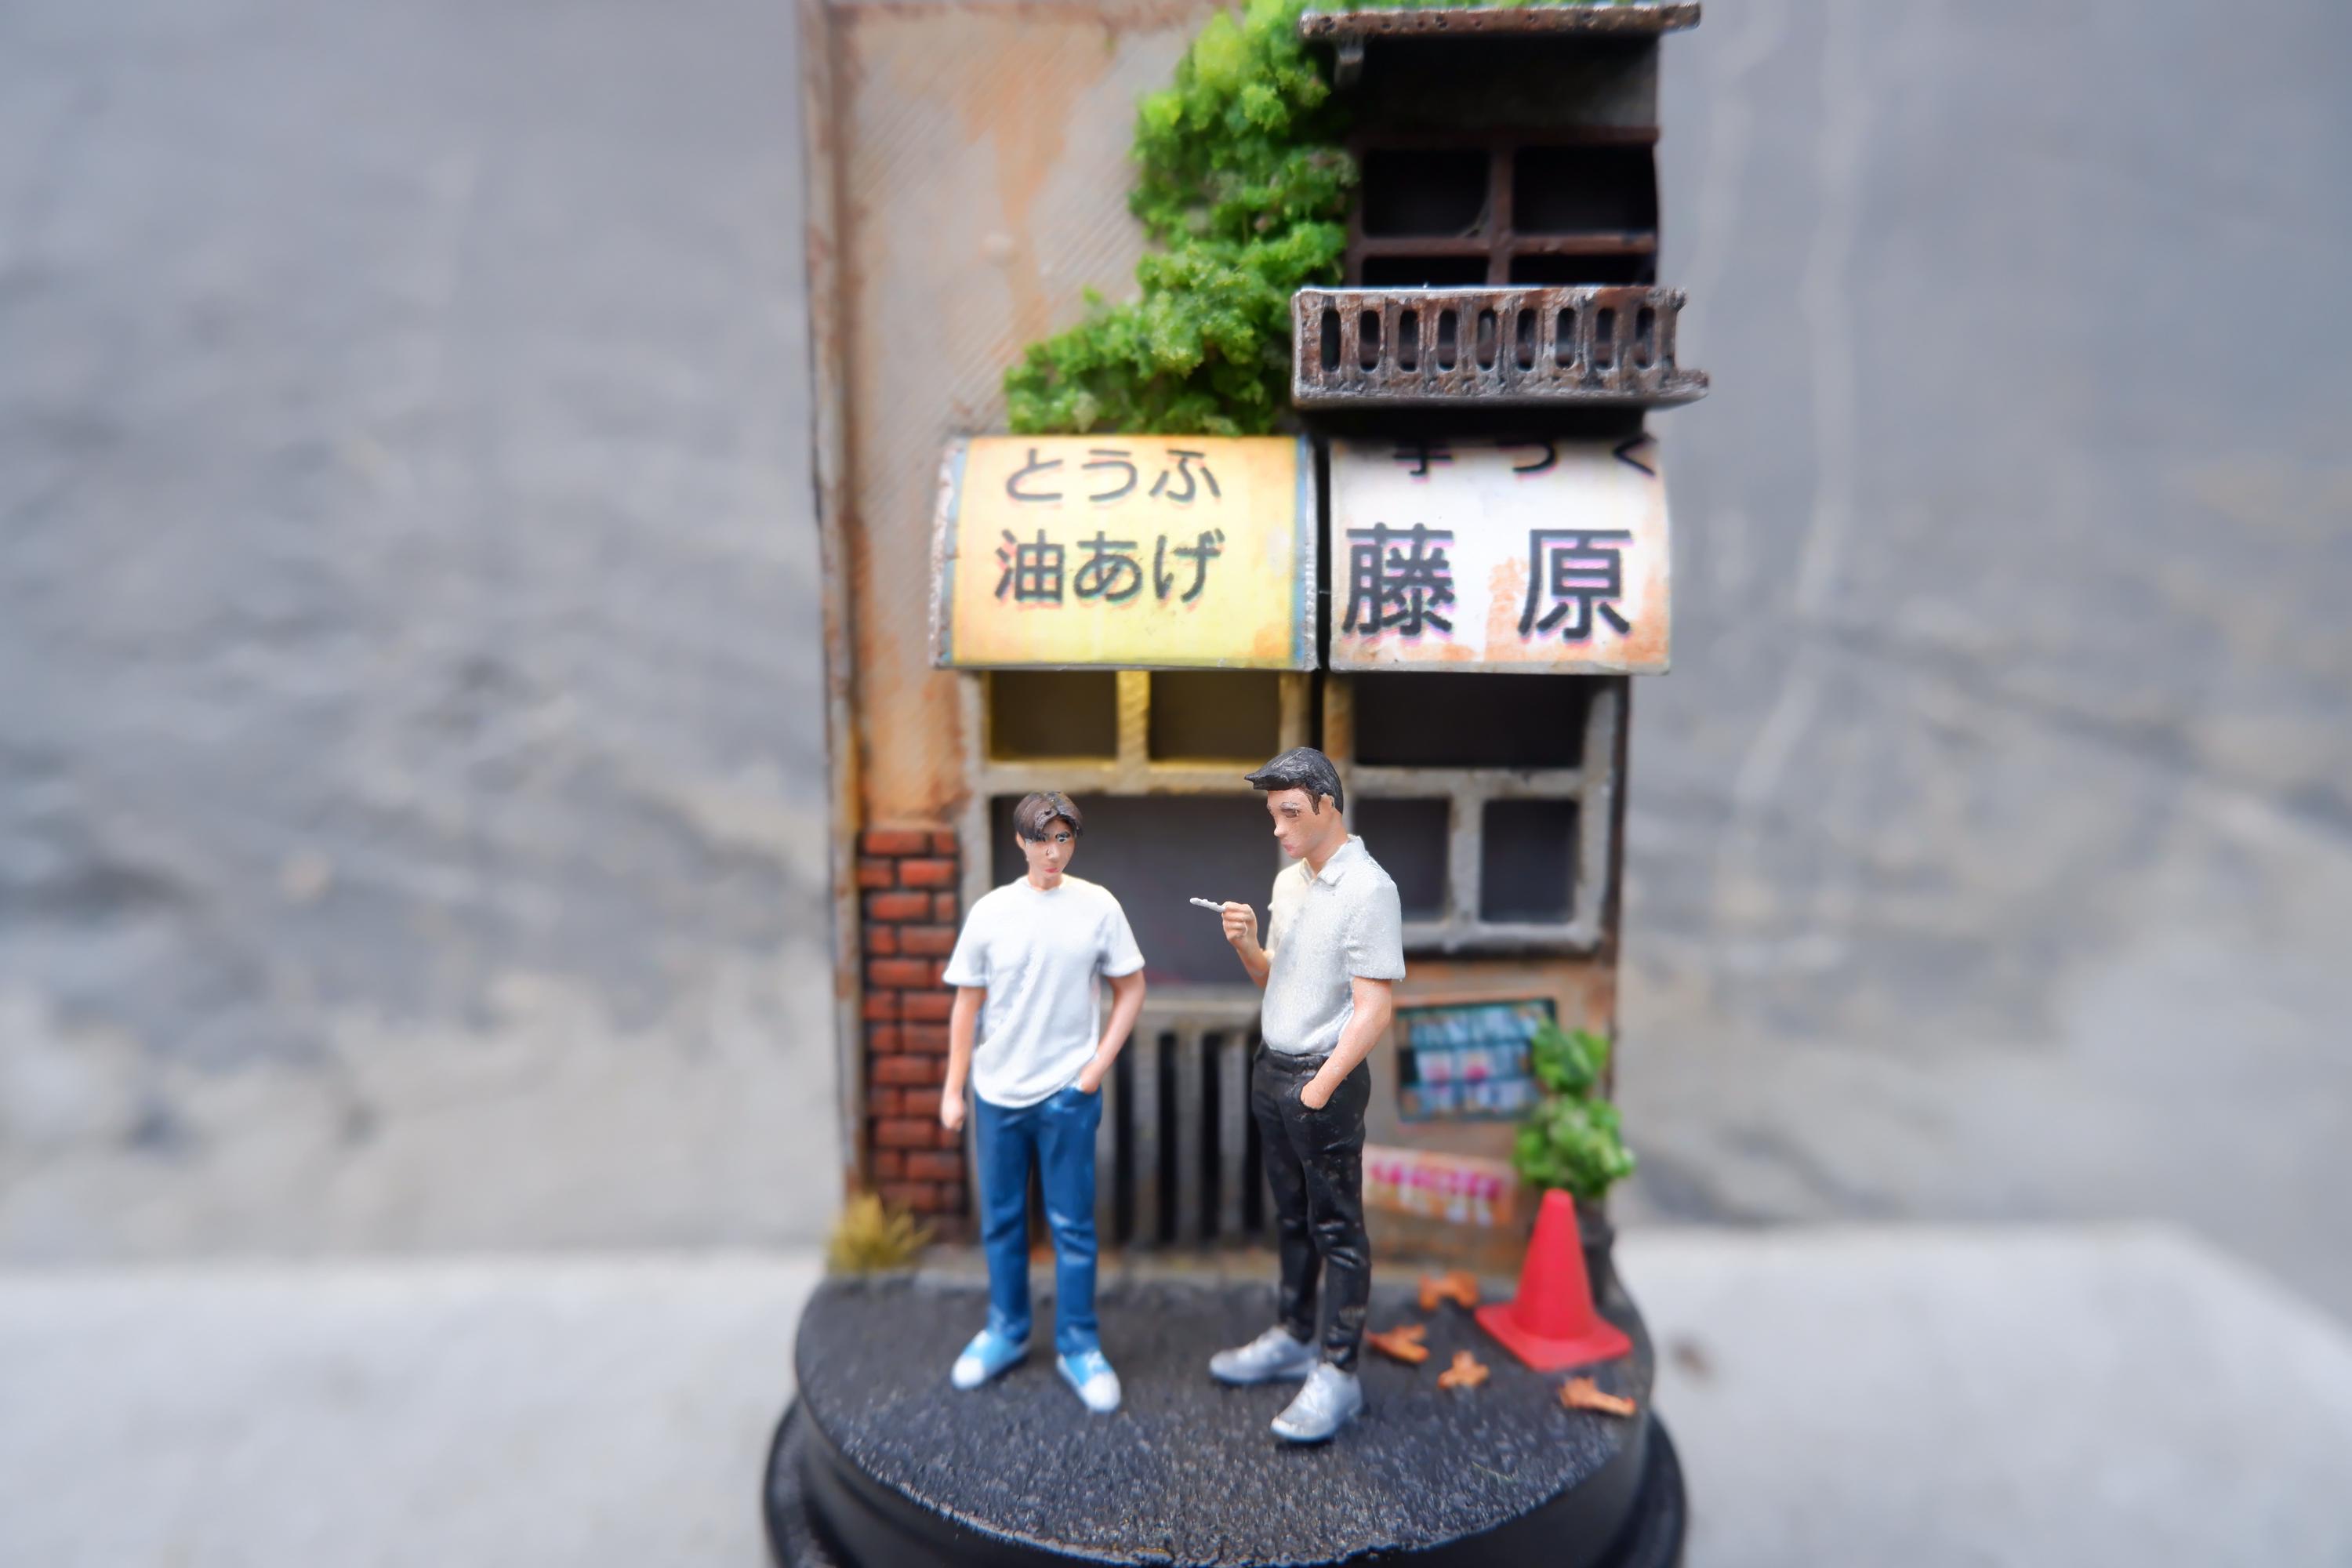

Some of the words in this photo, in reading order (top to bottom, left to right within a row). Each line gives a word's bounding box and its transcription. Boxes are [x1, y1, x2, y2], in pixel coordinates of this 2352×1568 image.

[1005, 448, 1222, 502] とうふ
[995, 528, 1225, 603] 油あげ
[1342, 522, 1632, 640] 藤原
